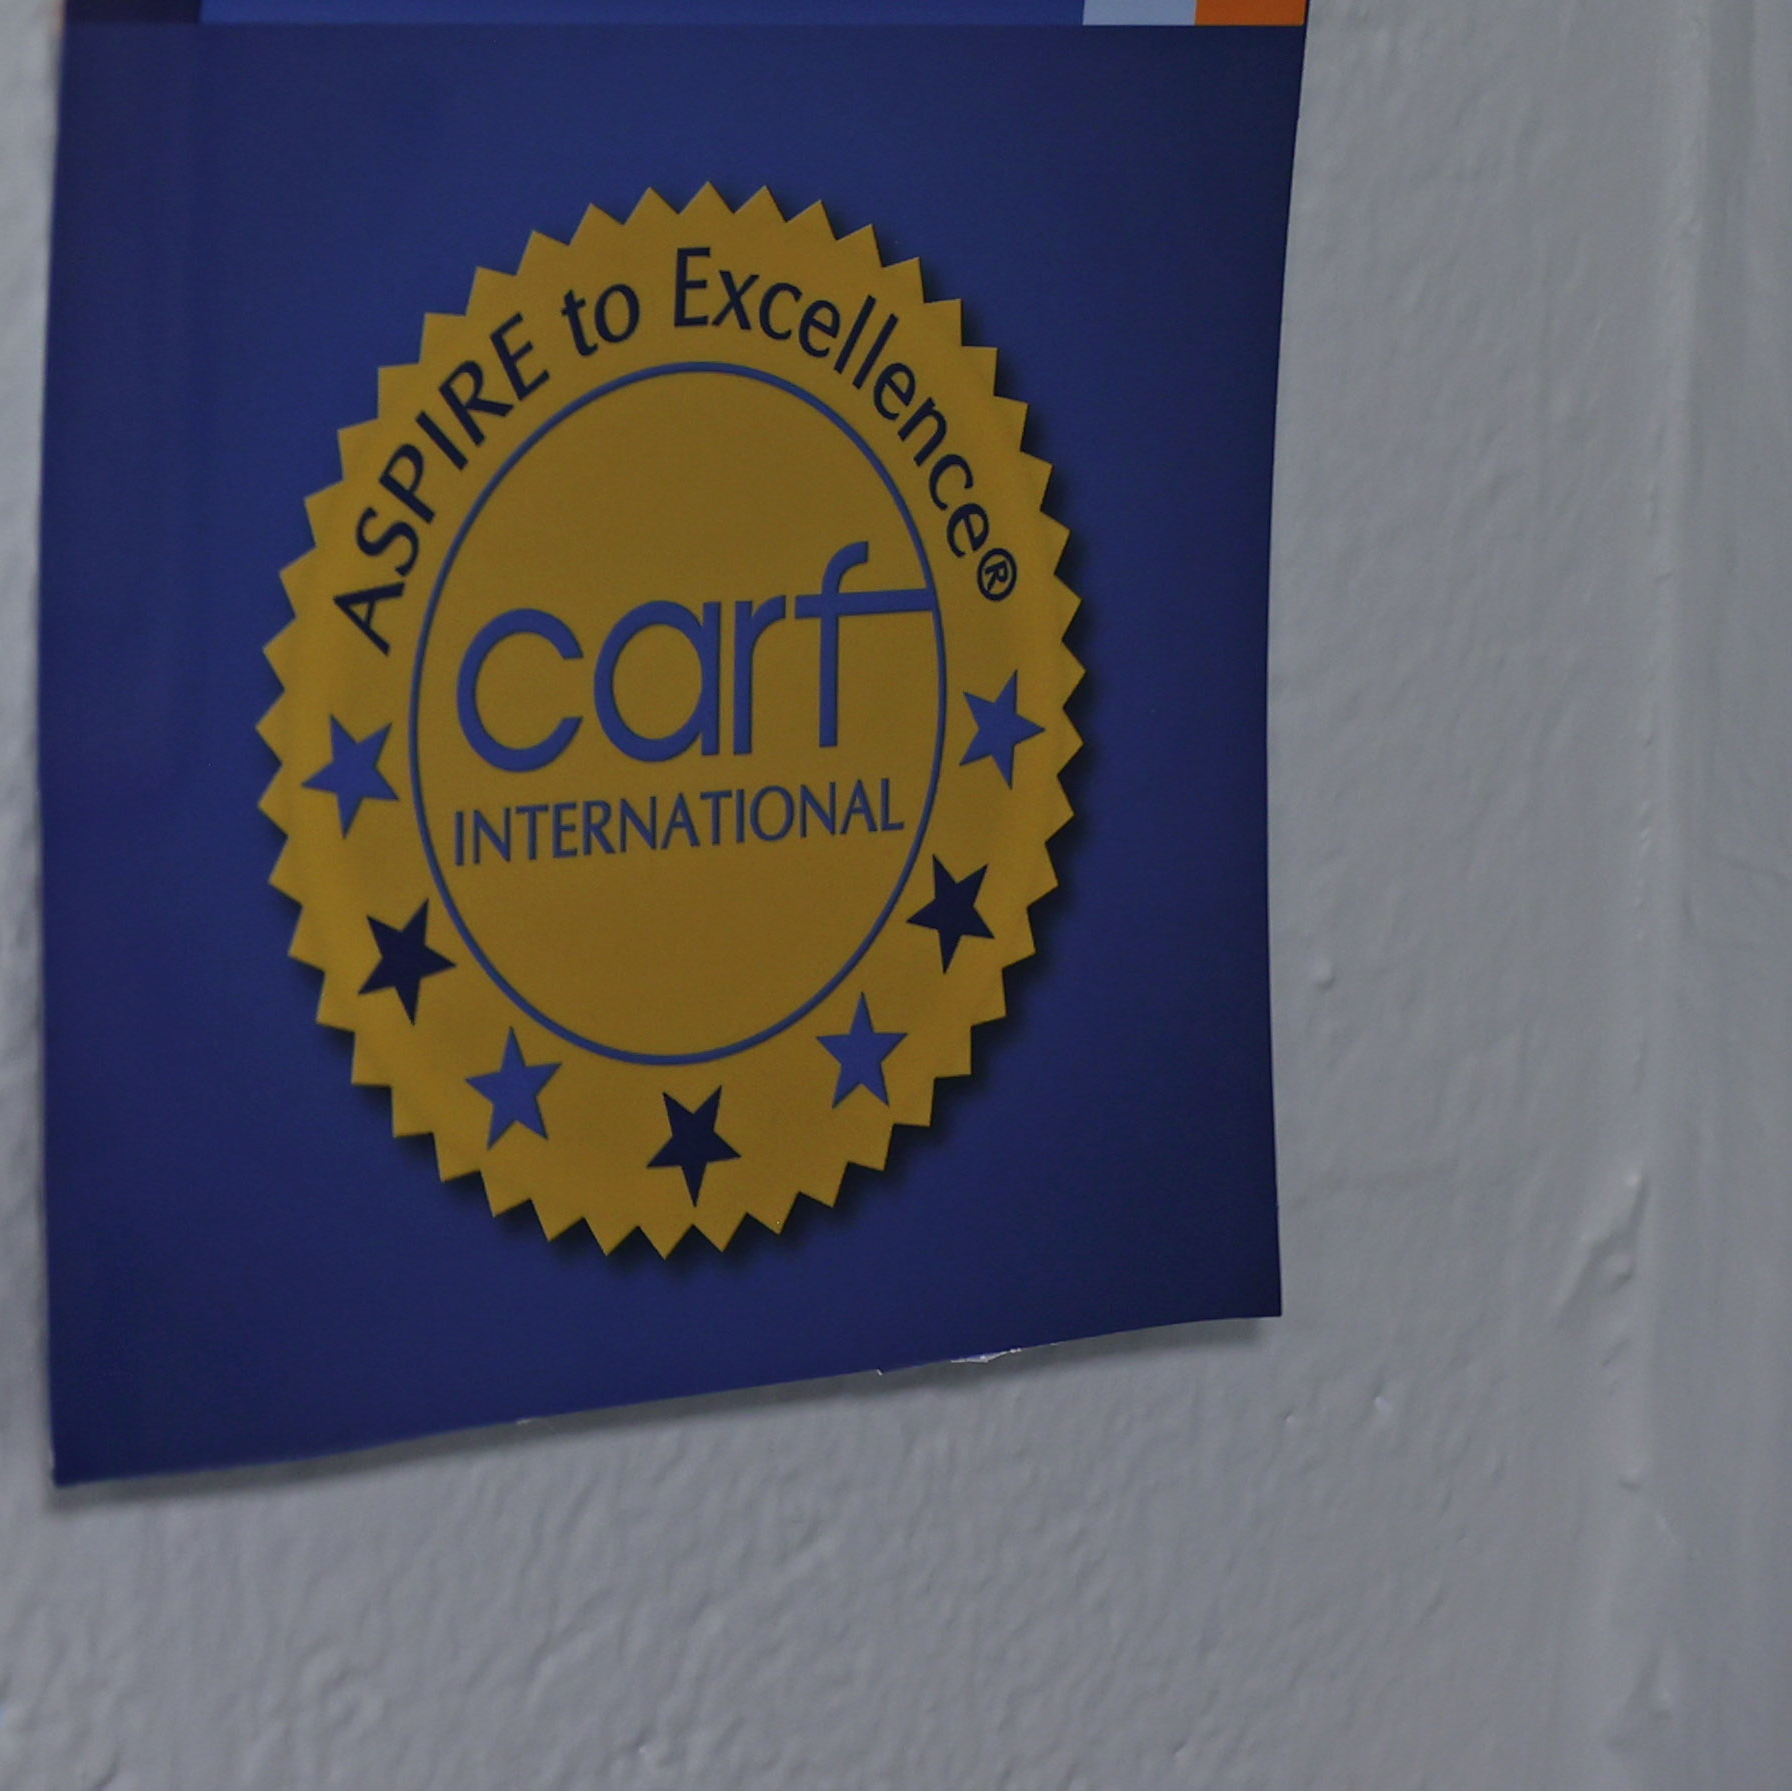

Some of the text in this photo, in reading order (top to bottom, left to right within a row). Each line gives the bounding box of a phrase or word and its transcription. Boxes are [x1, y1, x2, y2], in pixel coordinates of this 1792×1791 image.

[333, 312, 550, 656] ASPIRE
[560, 282, 640, 357] to
[455, 540, 932, 773] carf
[453, 776, 905, 868] INTERNATIONAL
